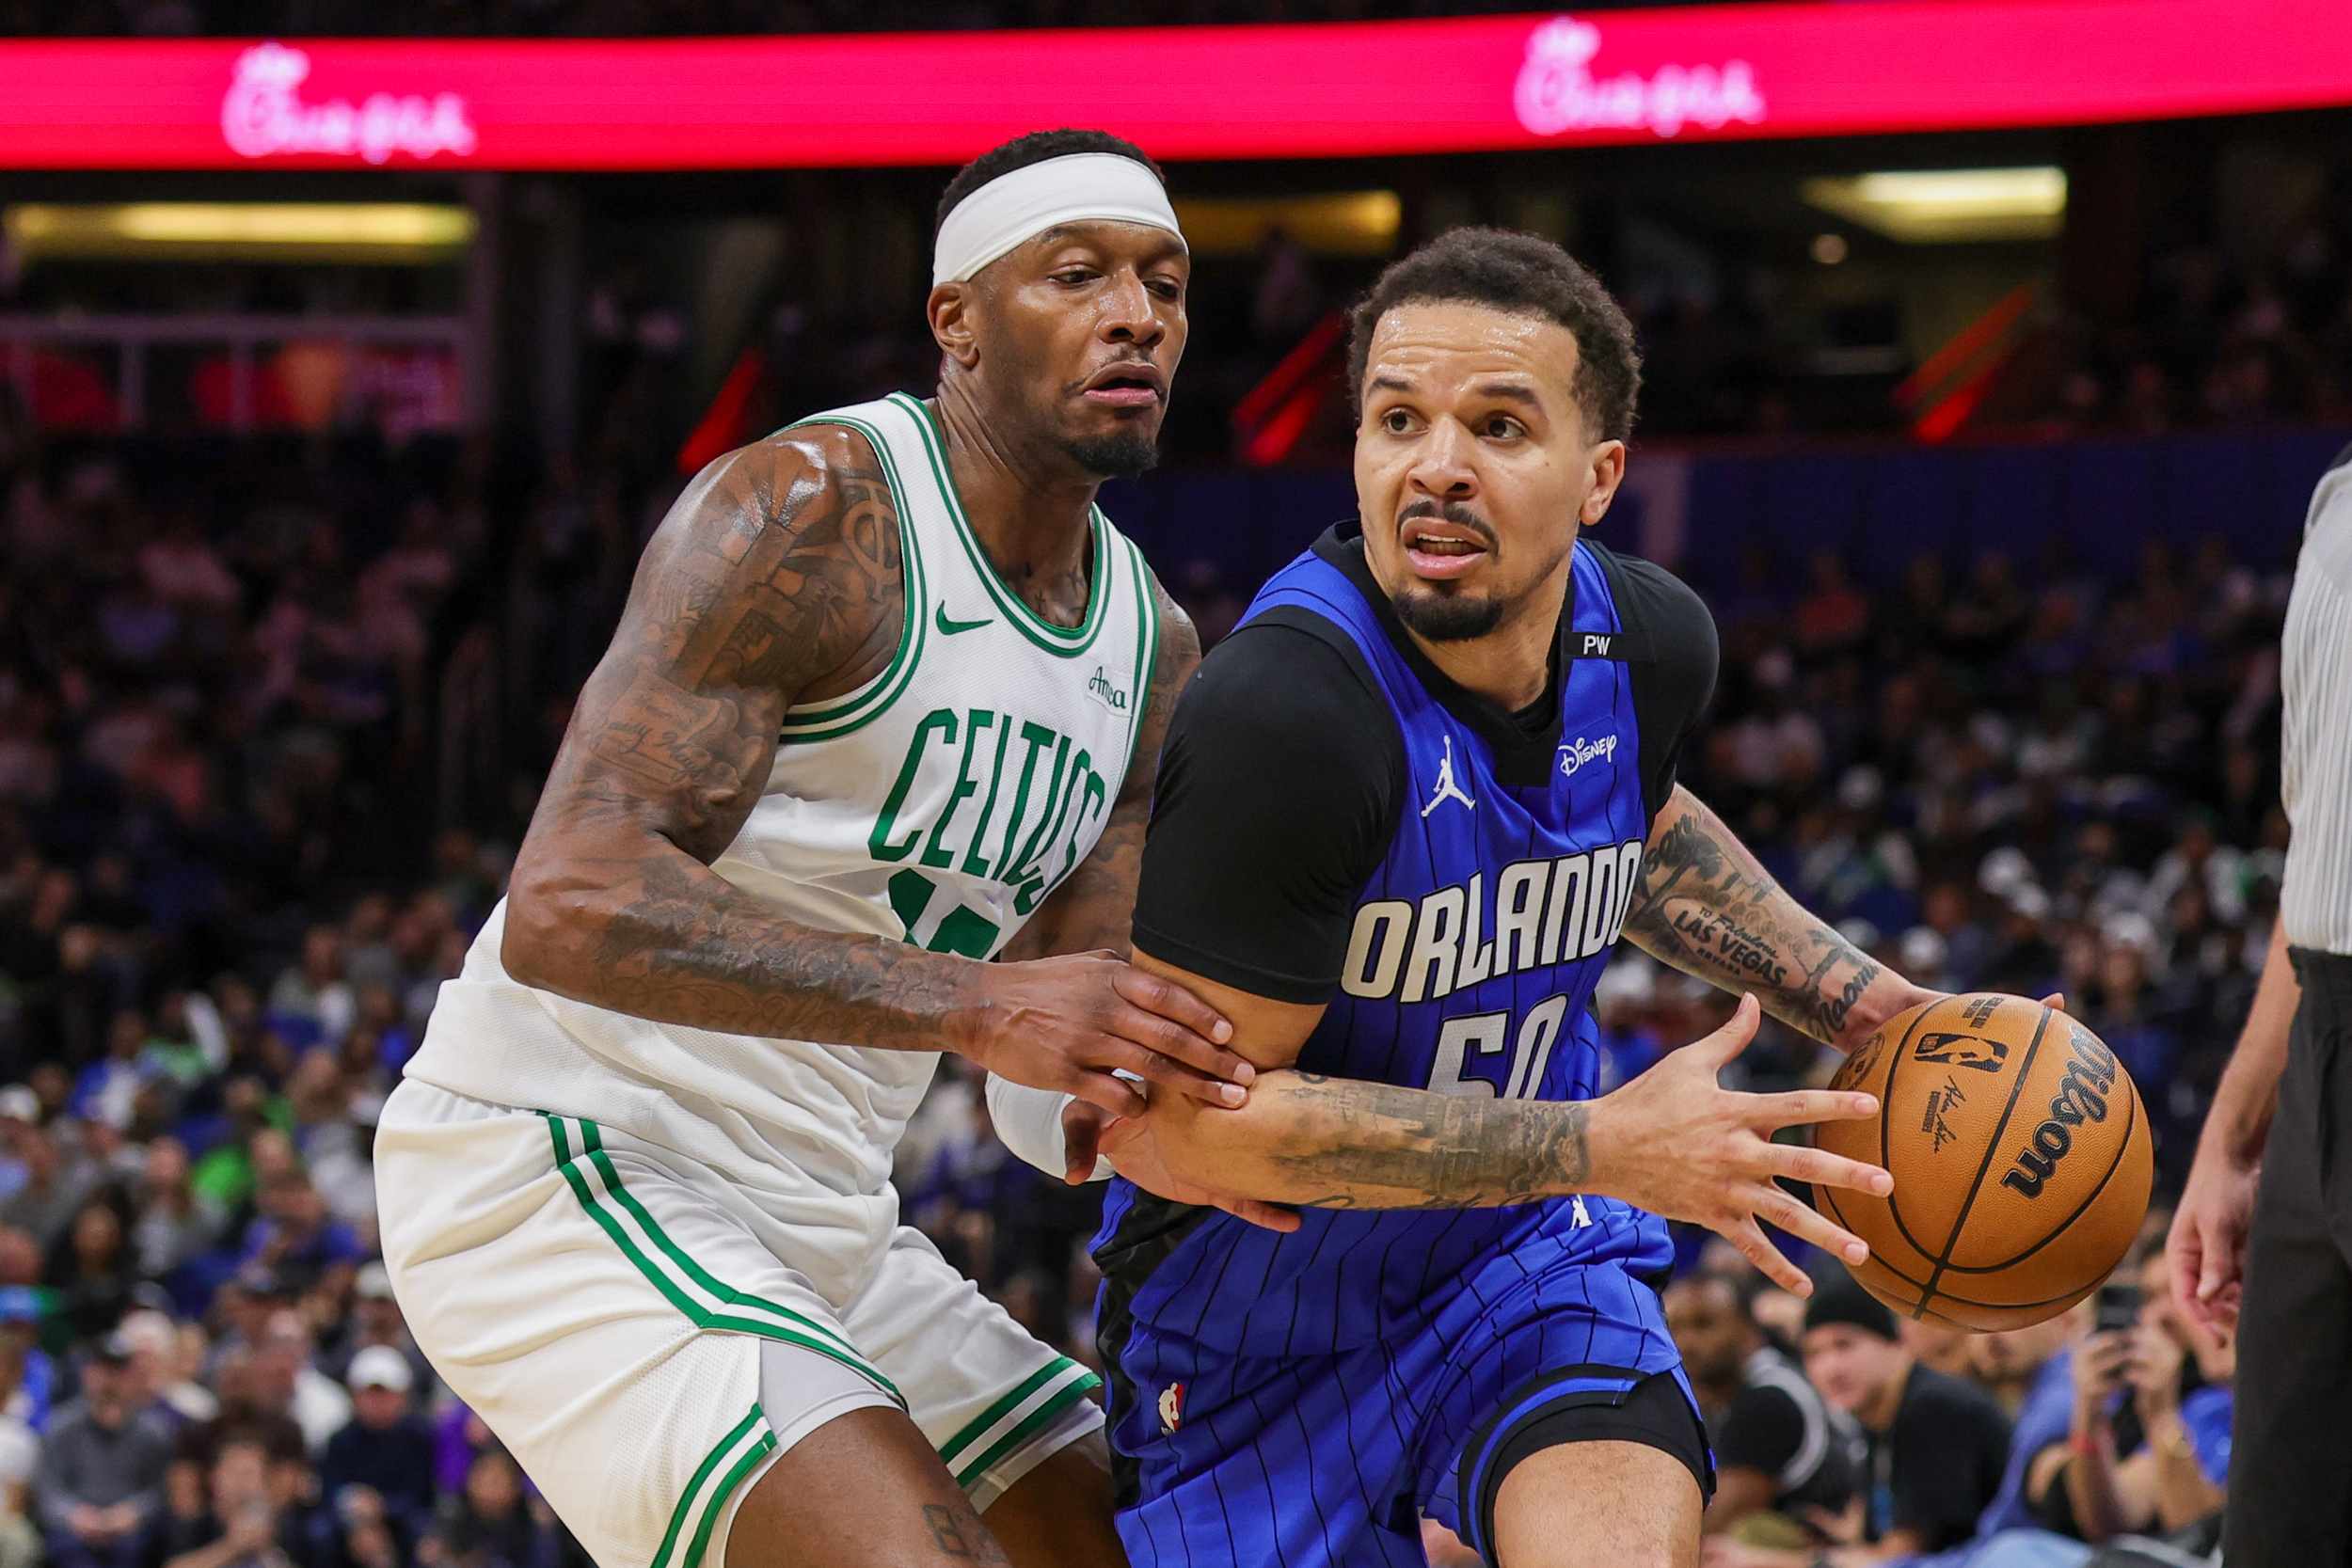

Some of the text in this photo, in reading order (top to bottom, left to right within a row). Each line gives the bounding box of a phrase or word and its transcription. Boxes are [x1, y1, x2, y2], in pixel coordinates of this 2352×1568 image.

[1582, 635, 1612, 656] PW
[1340, 838, 1645, 1004] ORLANDO
[1673, 909, 1718, 943] LAS
[1719, 932, 1788, 986] VEGAS
[1999, 1023, 2117, 1200] Wilson
